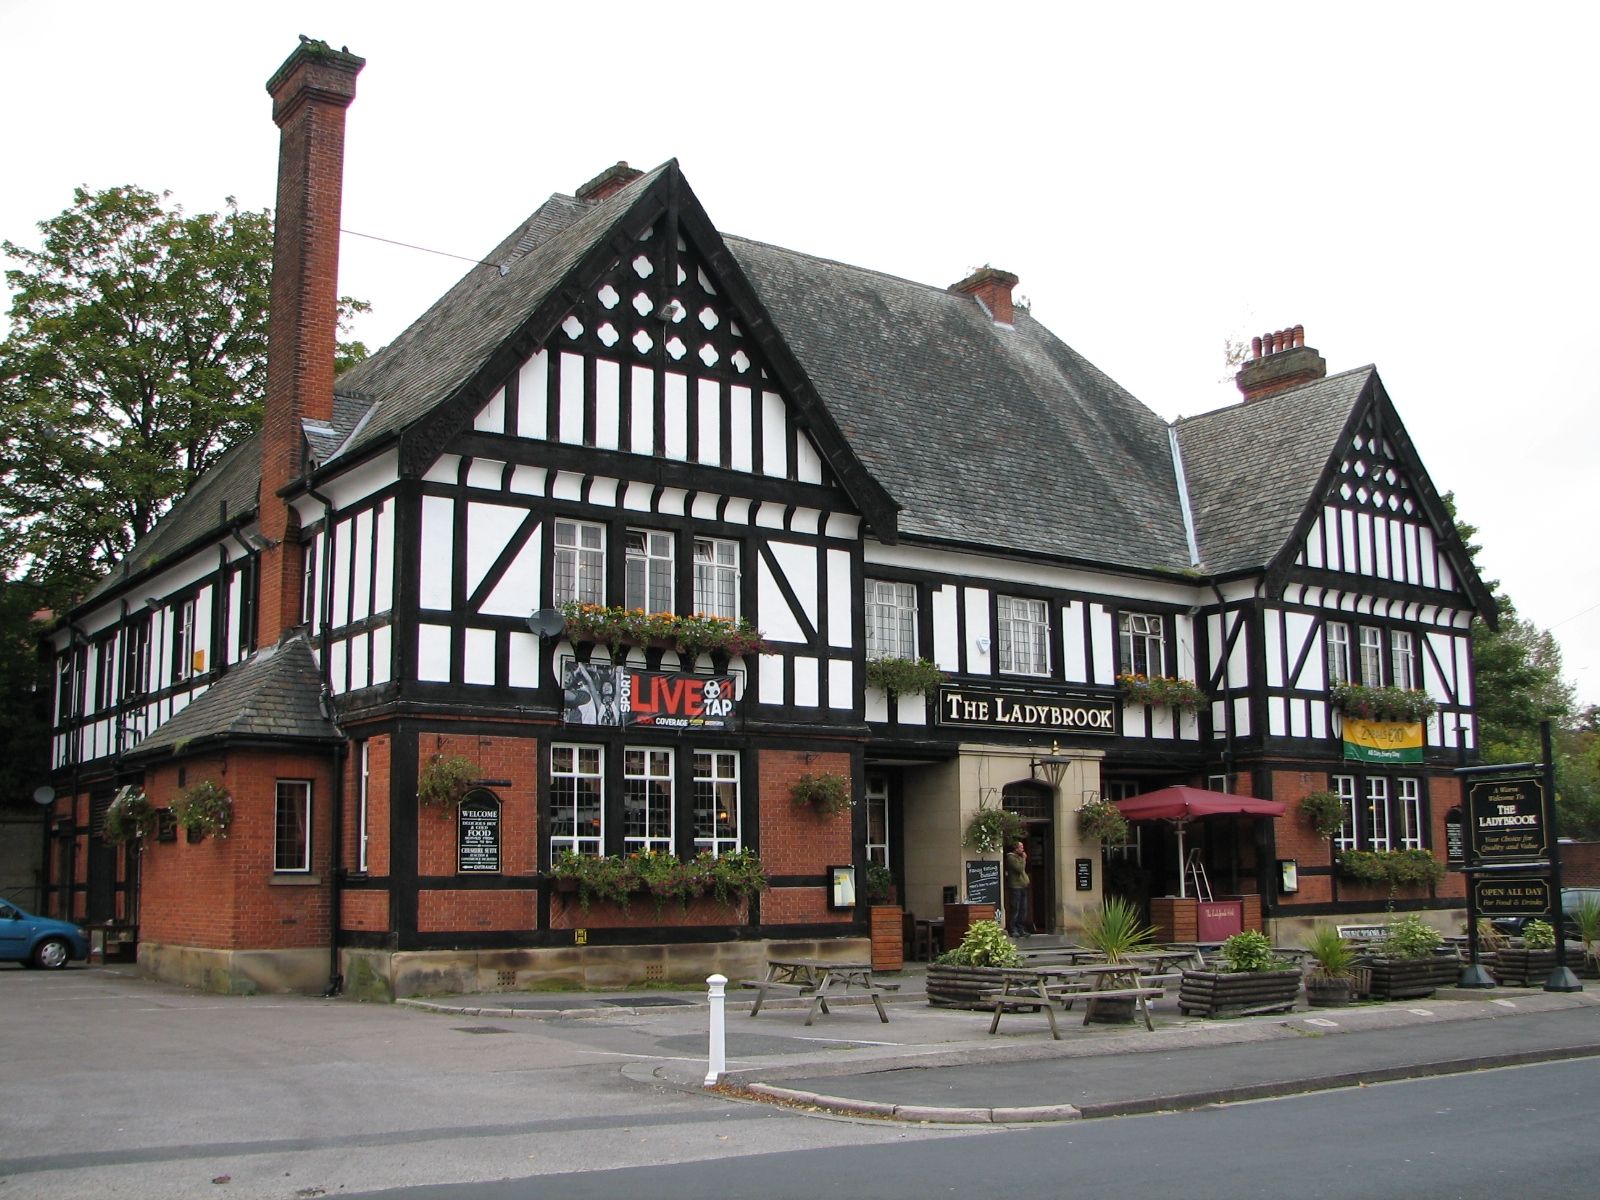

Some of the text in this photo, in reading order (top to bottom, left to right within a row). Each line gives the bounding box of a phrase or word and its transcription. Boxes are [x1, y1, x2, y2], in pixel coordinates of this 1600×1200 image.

[620, 673, 631, 713] SPORT
[631, 675, 705, 715] LIVE
[704, 699, 732, 716] TAP
[655, 717, 688, 726] COVERAGE
[1497, 804, 1516, 815] THE
[1479, 815, 1536, 826] LADYBROOK
[1481, 887, 1543, 896] OPEN ALL DAY
